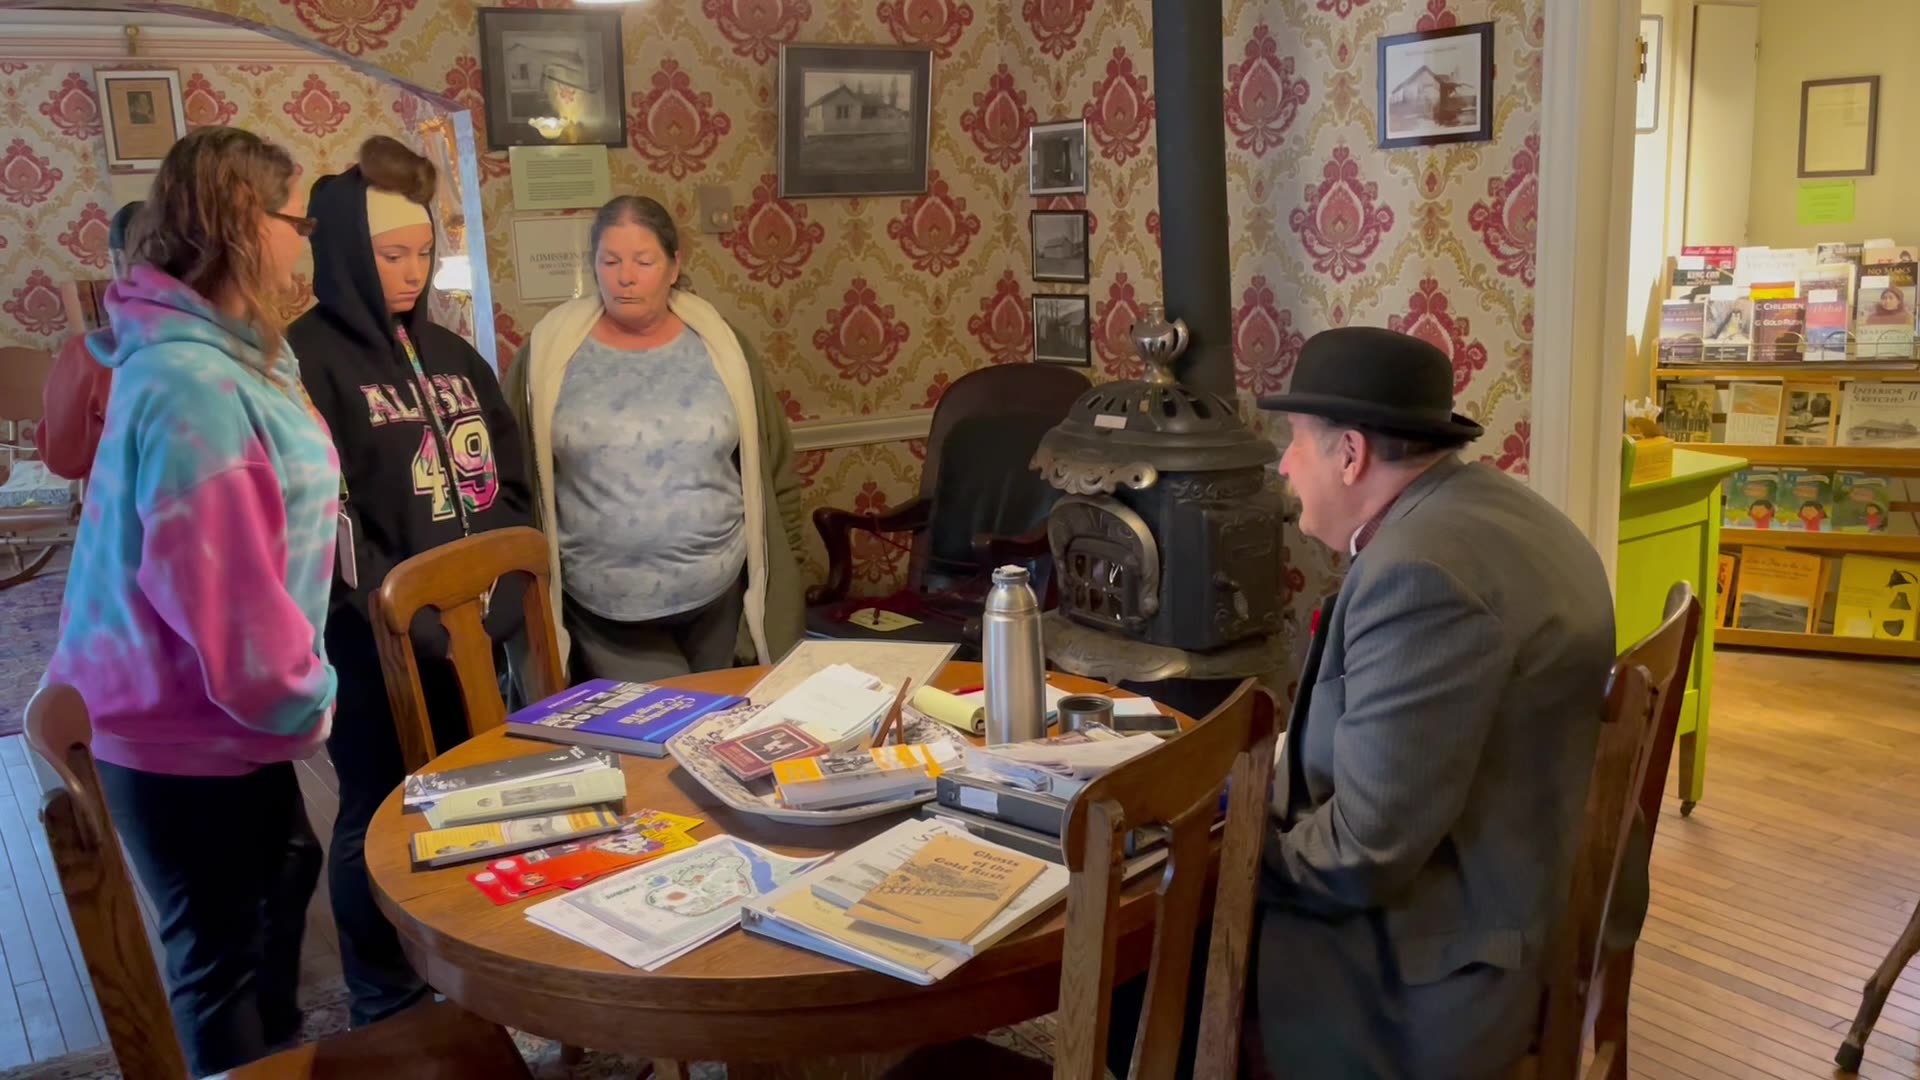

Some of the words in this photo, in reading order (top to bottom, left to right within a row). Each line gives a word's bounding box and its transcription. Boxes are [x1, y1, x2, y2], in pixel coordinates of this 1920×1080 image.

[1763, 302, 1805, 311] CHILDREN
[1762, 319, 1783, 327] GOLD
[1852, 385, 1903, 395] INTERIOR
[411, 415, 500, 522] 49
[973, 850, 1020, 867] Ghosts
[934, 857, 968, 871] Gold
[969, 867, 1006, 881] Rush
[972, 859, 989, 869] of
[990, 863, 1013, 874] the
